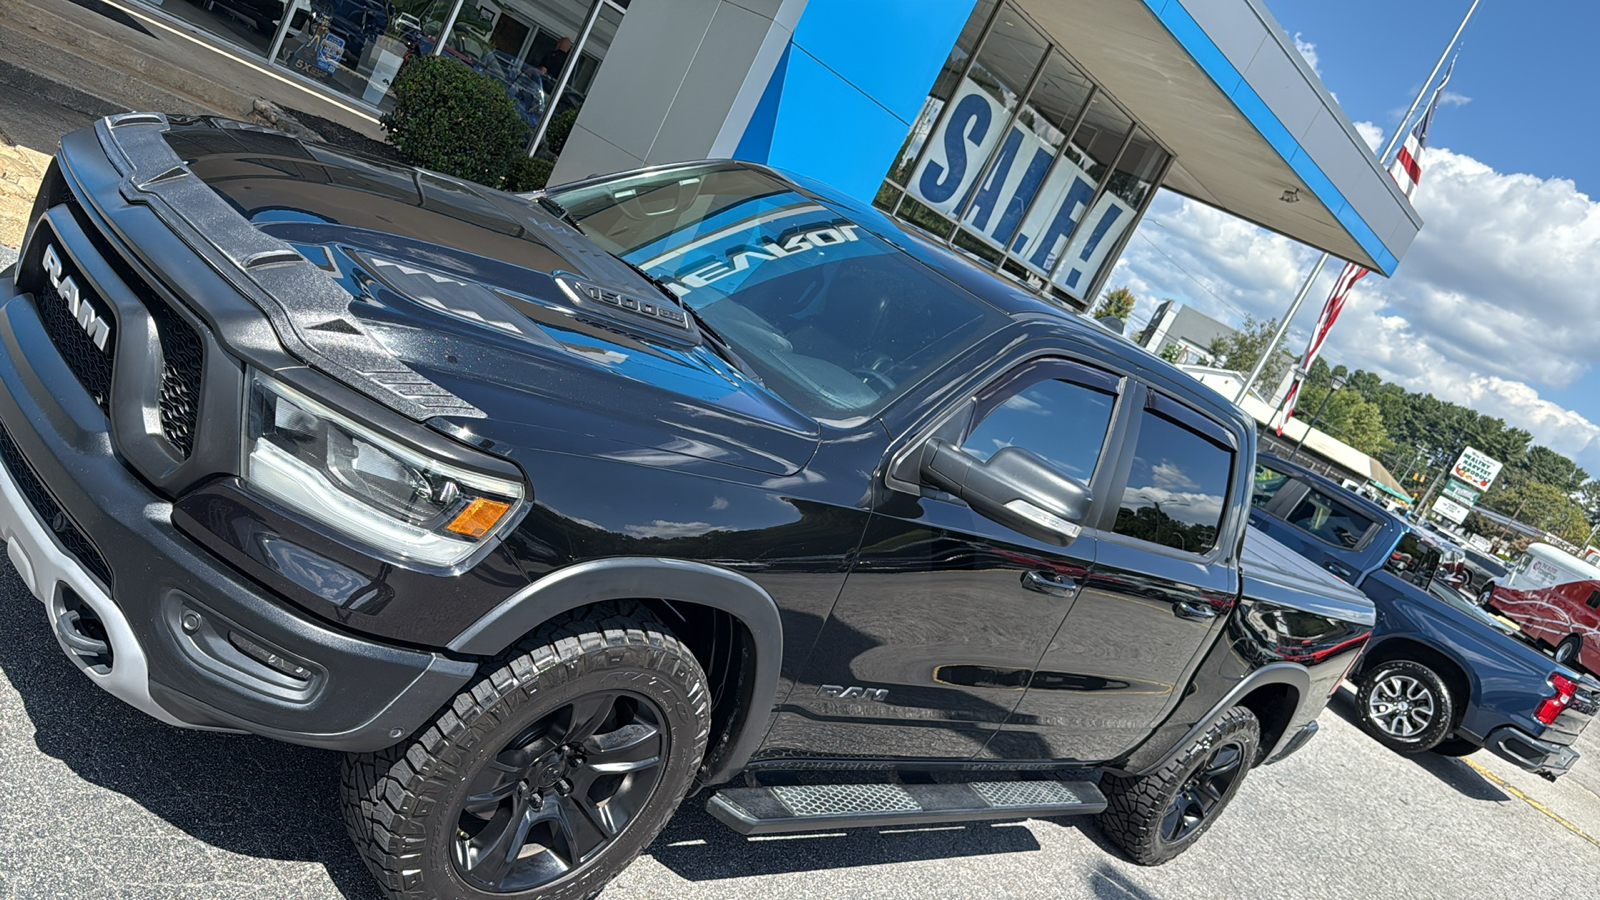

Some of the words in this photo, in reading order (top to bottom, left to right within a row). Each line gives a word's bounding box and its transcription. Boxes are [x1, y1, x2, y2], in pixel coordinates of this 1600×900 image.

[919, 93, 1123, 289] SALE!
[42, 243, 110, 352] RAM
[588, 287, 658, 316] 1500
[1463, 453, 1491, 470] HEALTHY
[1463, 459, 1492, 477] HARVEST
[1461, 465, 1491, 483] PRODUCE
[815, 684, 889, 702] RAM
